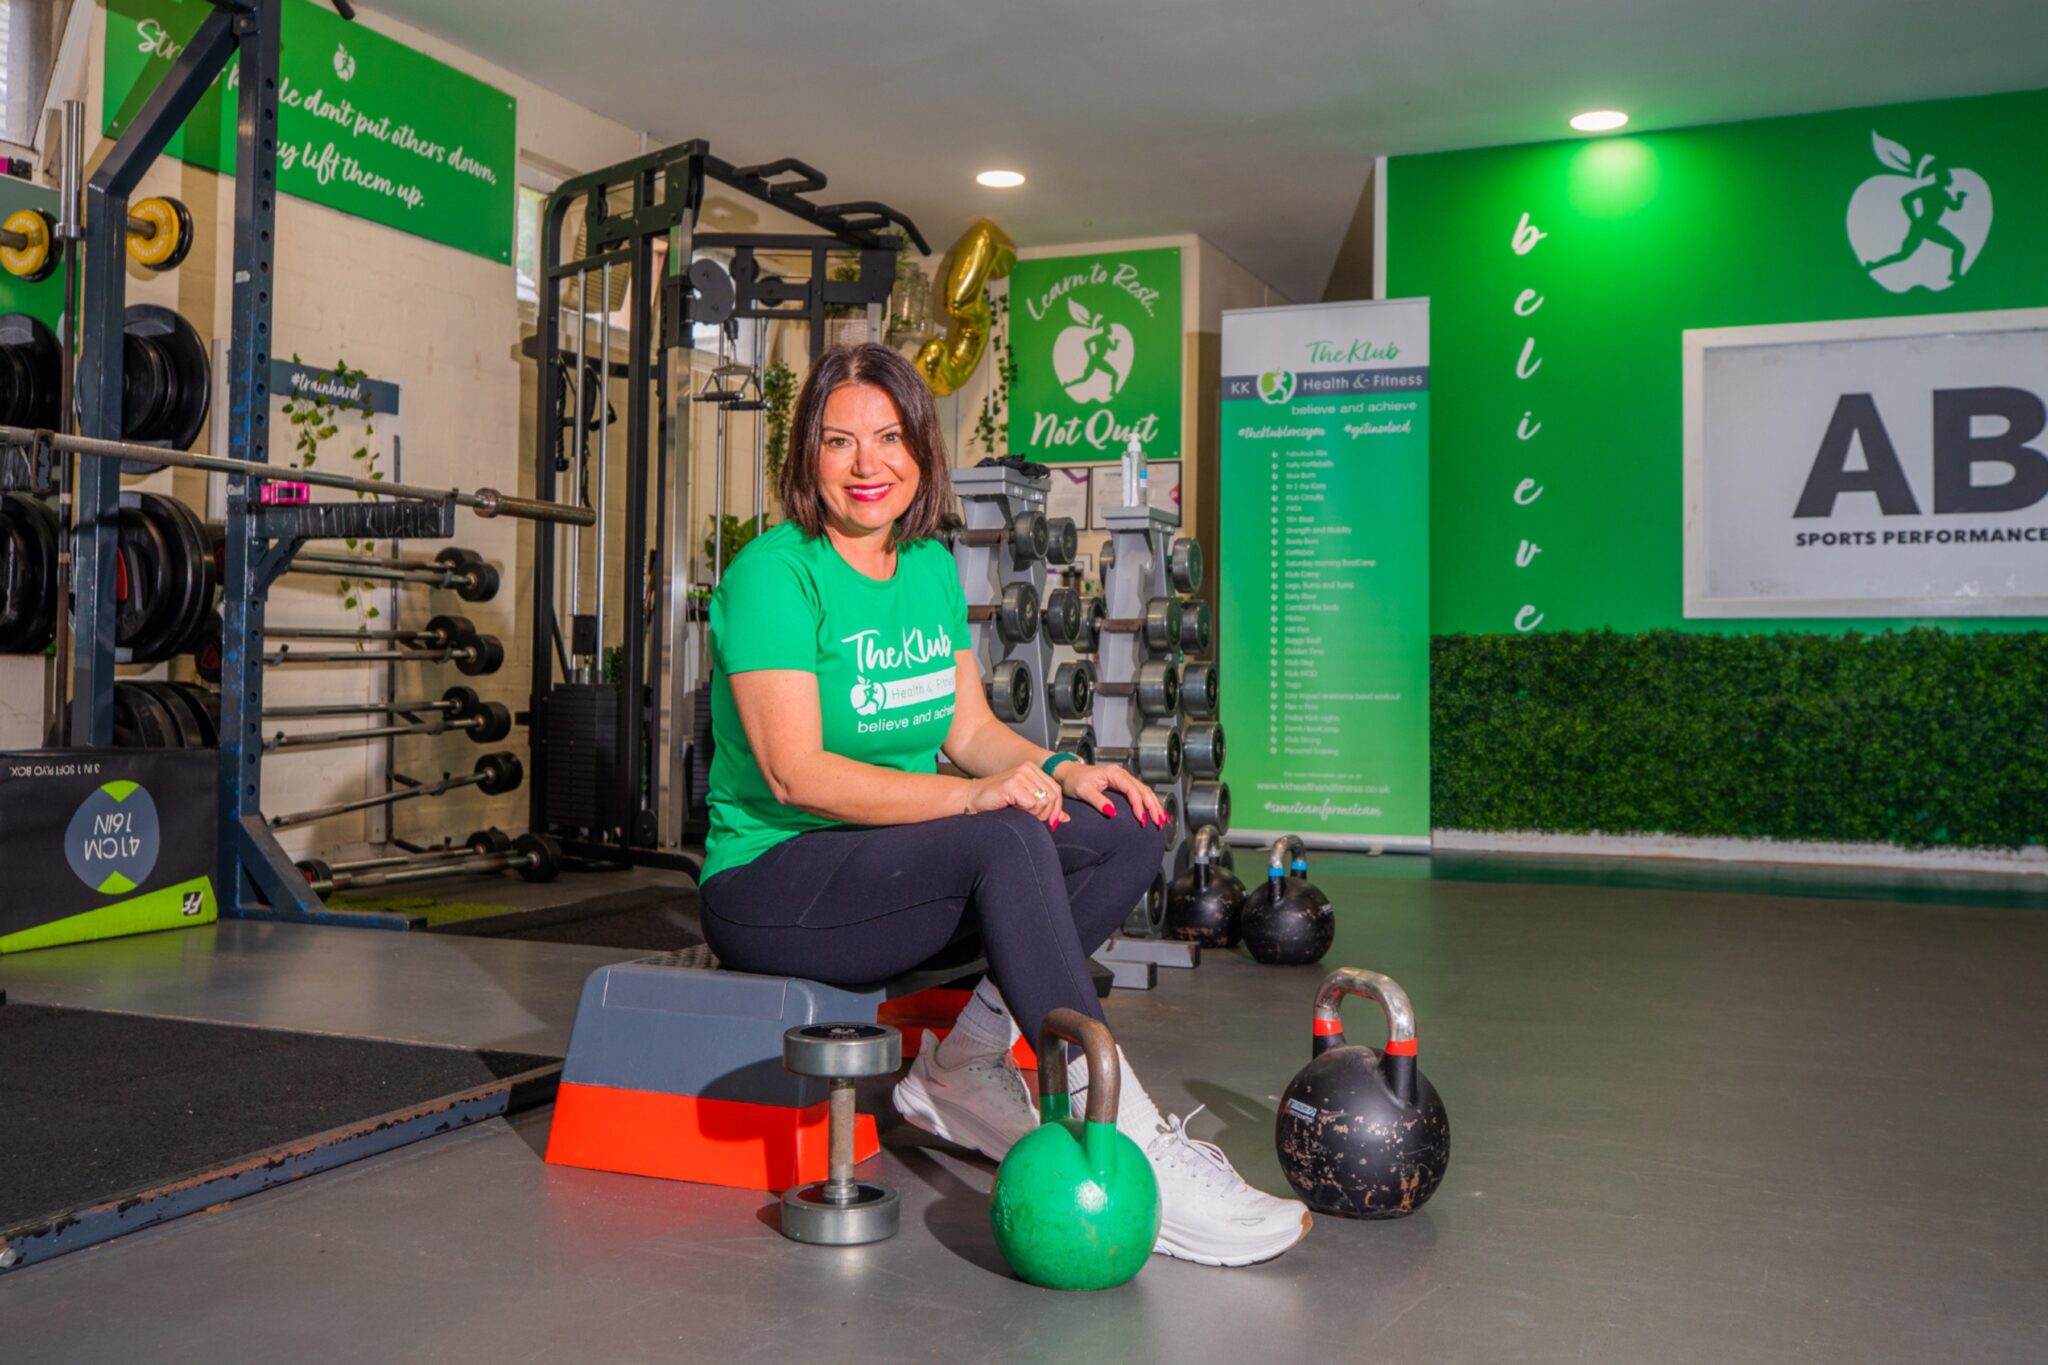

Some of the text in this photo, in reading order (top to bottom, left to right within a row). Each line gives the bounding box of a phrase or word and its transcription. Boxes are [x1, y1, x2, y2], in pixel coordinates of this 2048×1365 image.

[353, 112, 391, 141] put
[391, 126, 446, 163] others
[341, 157, 395, 195] them
[397, 183, 425, 210] up.
[1026, 272, 1088, 321] Learn
[1090, 263, 1108, 284] to
[1306, 338, 1401, 364] The Klub
[1230, 373, 1423, 396] KK Health & Fitness
[1291, 401, 1417, 415] believe and achieve
[1030, 409, 1159, 451] Not Quit
[1795, 526, 2048, 547] SPORTS PERFORMANCE
[840, 624, 953, 673] The Klub
[891, 683, 924, 700] Health
[857, 717, 909, 734] believe
[912, 710, 931, 726] and
[34, 765, 54, 777] PLYO
[55, 764, 75, 776] SOFT
[84, 763, 93, 774] IN
[94, 763, 101, 774] 3
